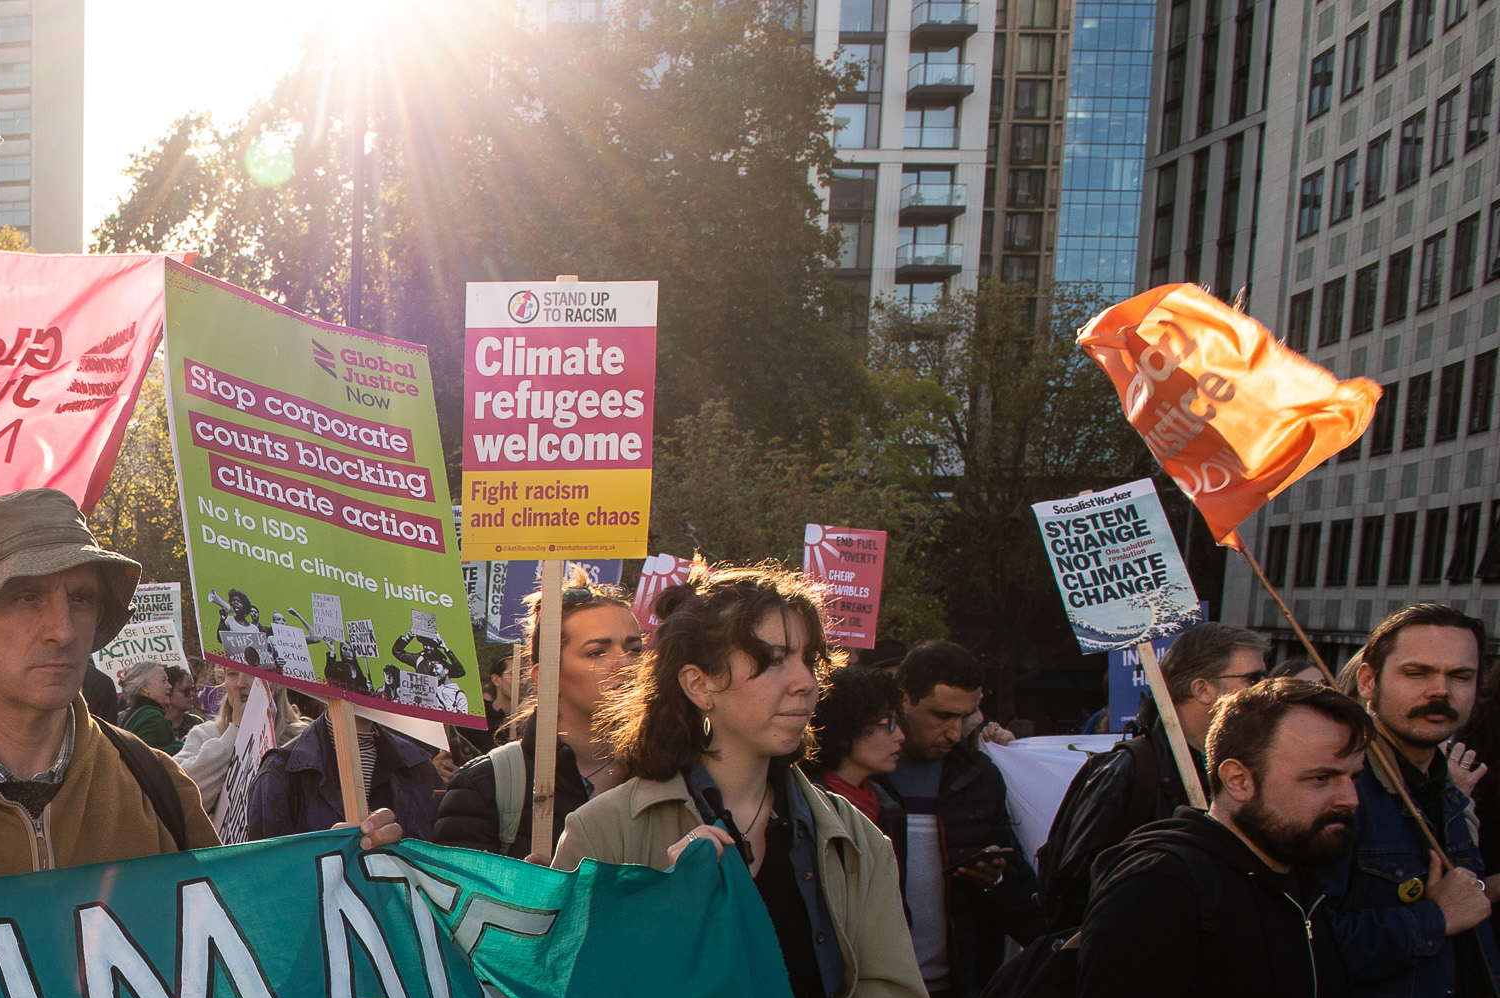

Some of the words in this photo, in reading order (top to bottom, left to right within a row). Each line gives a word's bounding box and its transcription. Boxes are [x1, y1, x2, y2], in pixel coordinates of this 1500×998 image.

[543, 291, 587, 307] STAND
[591, 291, 610, 306] UP
[543, 308, 562, 322] TO
[565, 308, 617, 322] RACISM
[340, 348, 417, 379] Global
[475, 336, 625, 377] Climate
[342, 366, 420, 398] Justice
[190, 365, 256, 411] Stop
[264, 394, 408, 453] corporate
[346, 385, 391, 411] Now
[474, 380, 645, 428] refugees
[1145, 372, 1236, 459] ustice
[473, 423, 642, 462] welcome
[195, 420, 288, 462] courts
[298, 440, 426, 498] blocking
[217, 464, 334, 517] climate
[342, 504, 439, 546] action
[471, 480, 519, 505] Fight
[525, 480, 589, 500] racism
[1052, 498, 1096, 515] Socialist
[1094, 490, 1132, 507] Worker
[198, 496, 227, 523] No
[234, 505, 255, 530] to
[262, 514, 308, 545] ISDS
[470, 507, 505, 527] and
[511, 507, 579, 527] climate
[586, 506, 640, 526] chaos
[1044, 504, 1139, 538] SYSTEM
[836, 536, 854, 548] END
[857, 538, 879, 550] FUEL
[1051, 519, 1151, 556] CHANGE
[202, 524, 295, 570] Demand
[301, 555, 378, 592] climate
[383, 578, 454, 608] justice
[839, 551, 878, 564] POVERTY
[1056, 550, 1102, 574] NOT
[1105, 547, 1121, 556] One
[1121, 538, 1156, 553] solution:
[1108, 548, 1147, 563] revolution
[828, 569, 856, 582] CHEAP
[1062, 552, 1167, 591] CLIMATE
[132, 593, 171, 603] SYSTEM
[829, 584, 870, 598] EWABLES
[1068, 570, 1169, 608] CHANGE
[132, 612, 152, 621] NOT
[136, 602, 174, 612] HANGE
[840, 601, 874, 614] BREAKS
[124, 628, 138, 638] BE
[142, 625, 167, 635] LESS
[849, 616, 863, 628] OIL
[99, 635, 174, 661] ACTIVIST
[105, 661, 114, 670] IF
[160, 653, 181, 662] LESS
